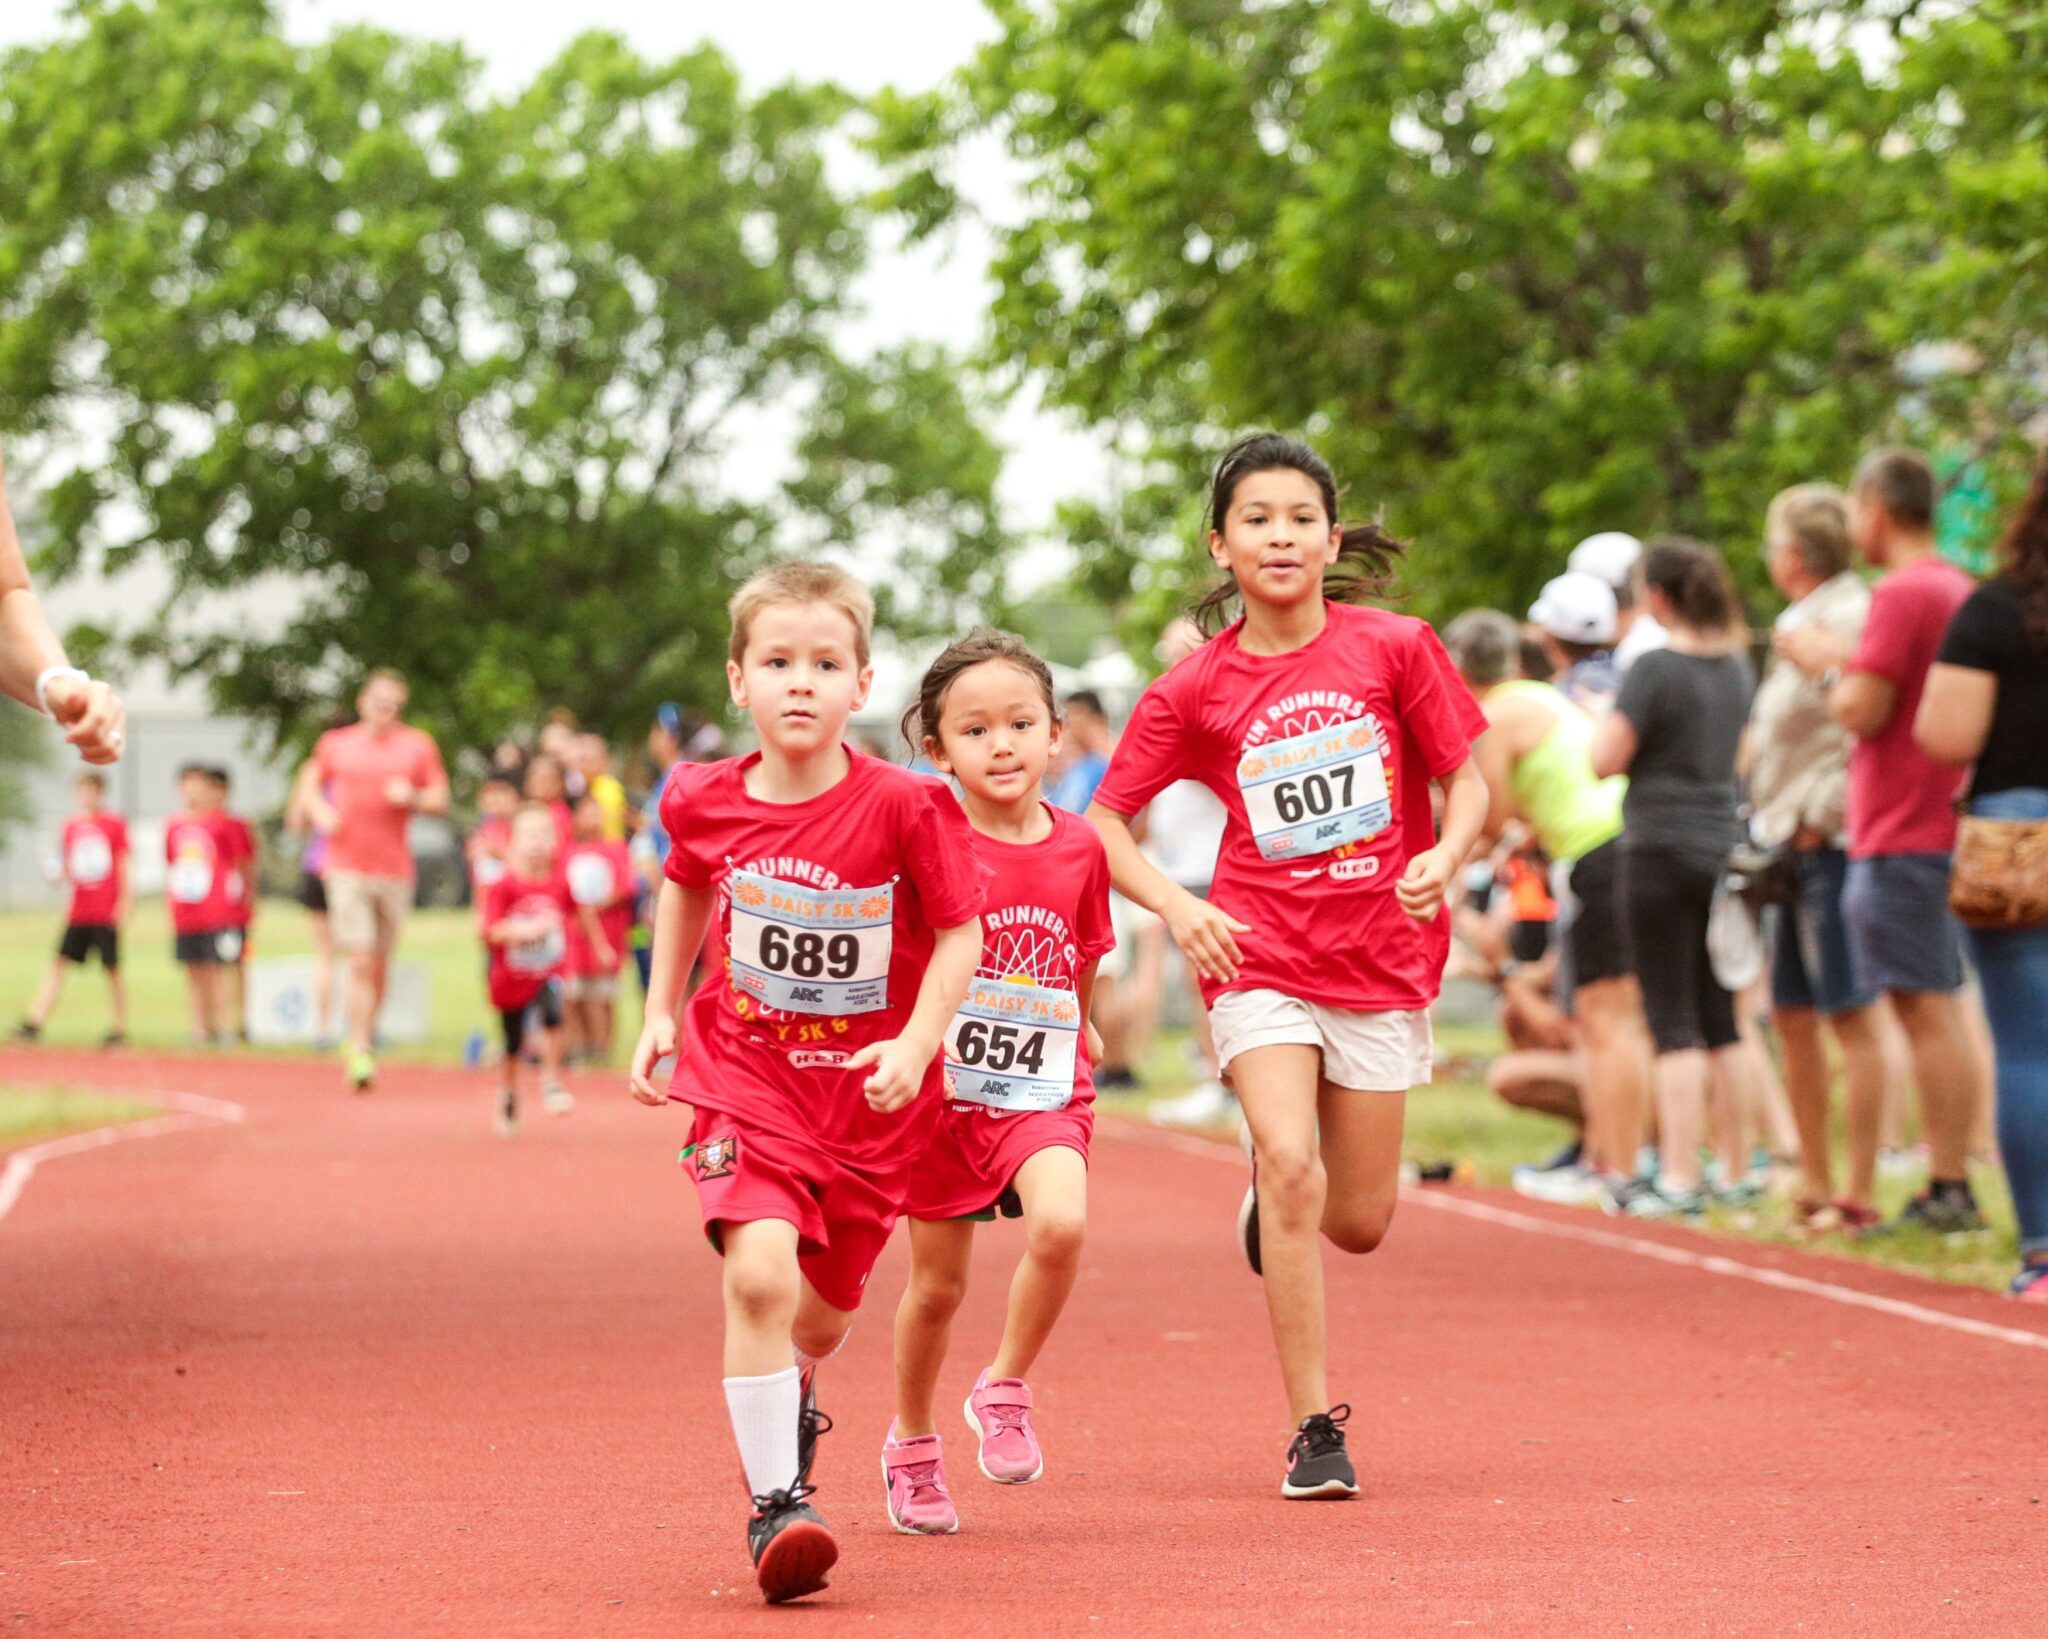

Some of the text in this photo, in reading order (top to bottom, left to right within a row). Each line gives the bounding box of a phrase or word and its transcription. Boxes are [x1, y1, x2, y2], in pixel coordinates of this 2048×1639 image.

[1266, 690, 1366, 722] RUNNERS
[1270, 745, 1320, 769] DAISY
[1324, 737, 1344, 754] 5K
[1273, 764, 1355, 823] 607
[1315, 822, 1342, 840] ARC
[770, 893, 826, 918] DAISY
[834, 903, 856, 918] 5K
[986, 905, 1068, 943] RUNNERS
[759, 924, 860, 979] 689
[789, 986, 824, 1003] ARC
[973, 991, 1029, 1014] DAISY
[1030, 999, 1050, 1016] 5K
[798, 1022, 827, 1042] 5K
[830, 1017, 849, 1033] &
[957, 1021, 1046, 1075] 654
[980, 1079, 1011, 1097] ARC
